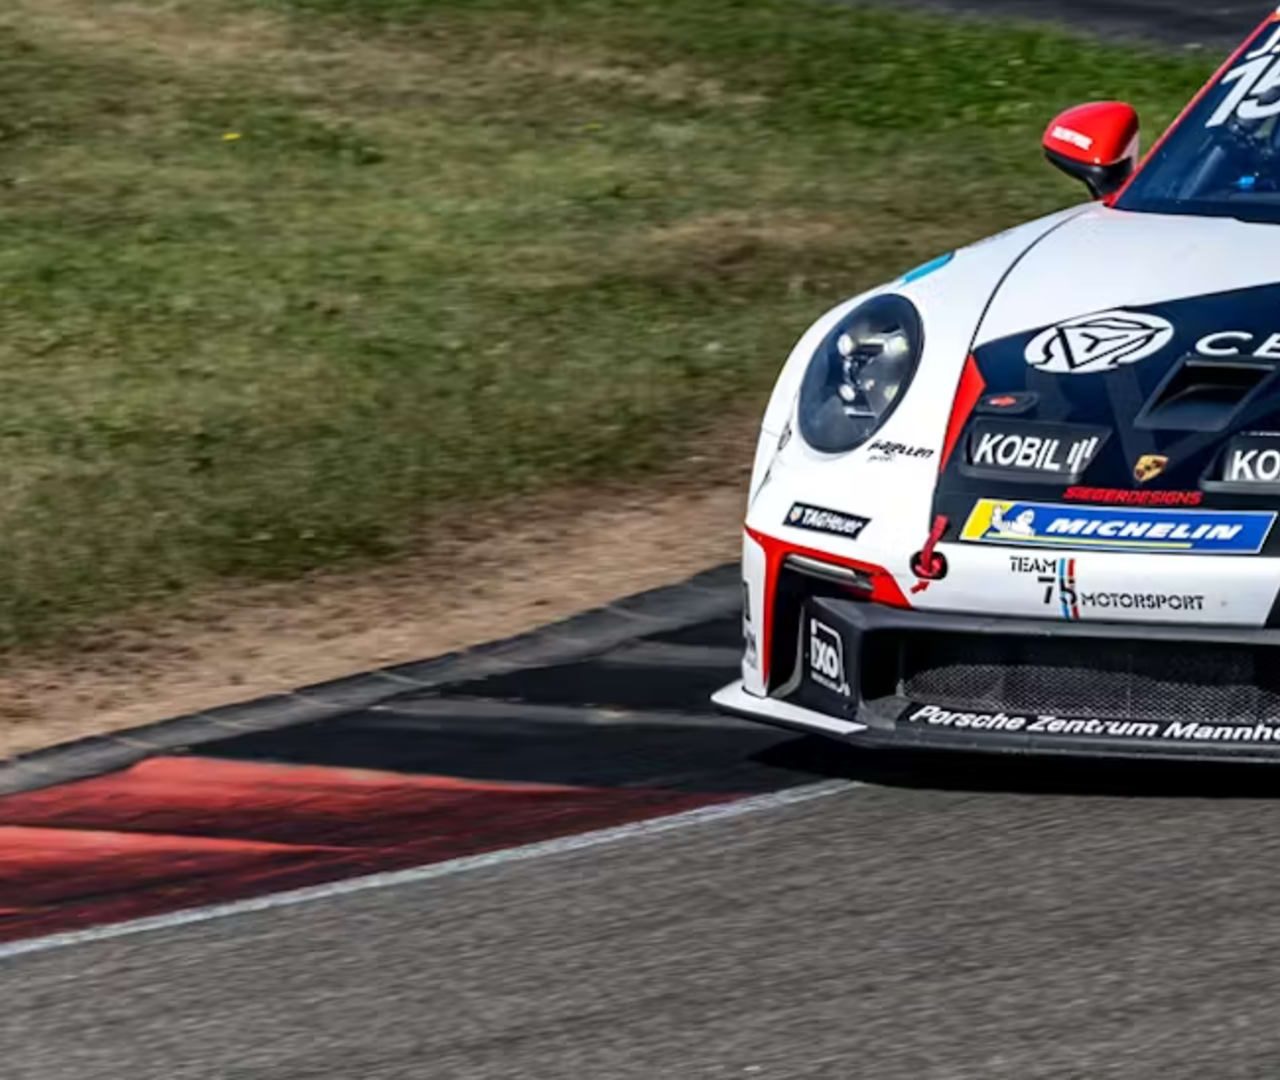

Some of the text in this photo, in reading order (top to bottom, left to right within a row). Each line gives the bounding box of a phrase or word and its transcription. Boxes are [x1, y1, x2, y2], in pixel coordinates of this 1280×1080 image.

[973, 432, 1062, 472] KOBIL
[1044, 517, 1244, 542] MICHELIN
[1008, 556, 1057, 576] TEAM
[1081, 592, 1205, 612] MOTORSPORT
[909, 704, 1025, 732] Porsche
[1028, 713, 1162, 739] Zentrum
